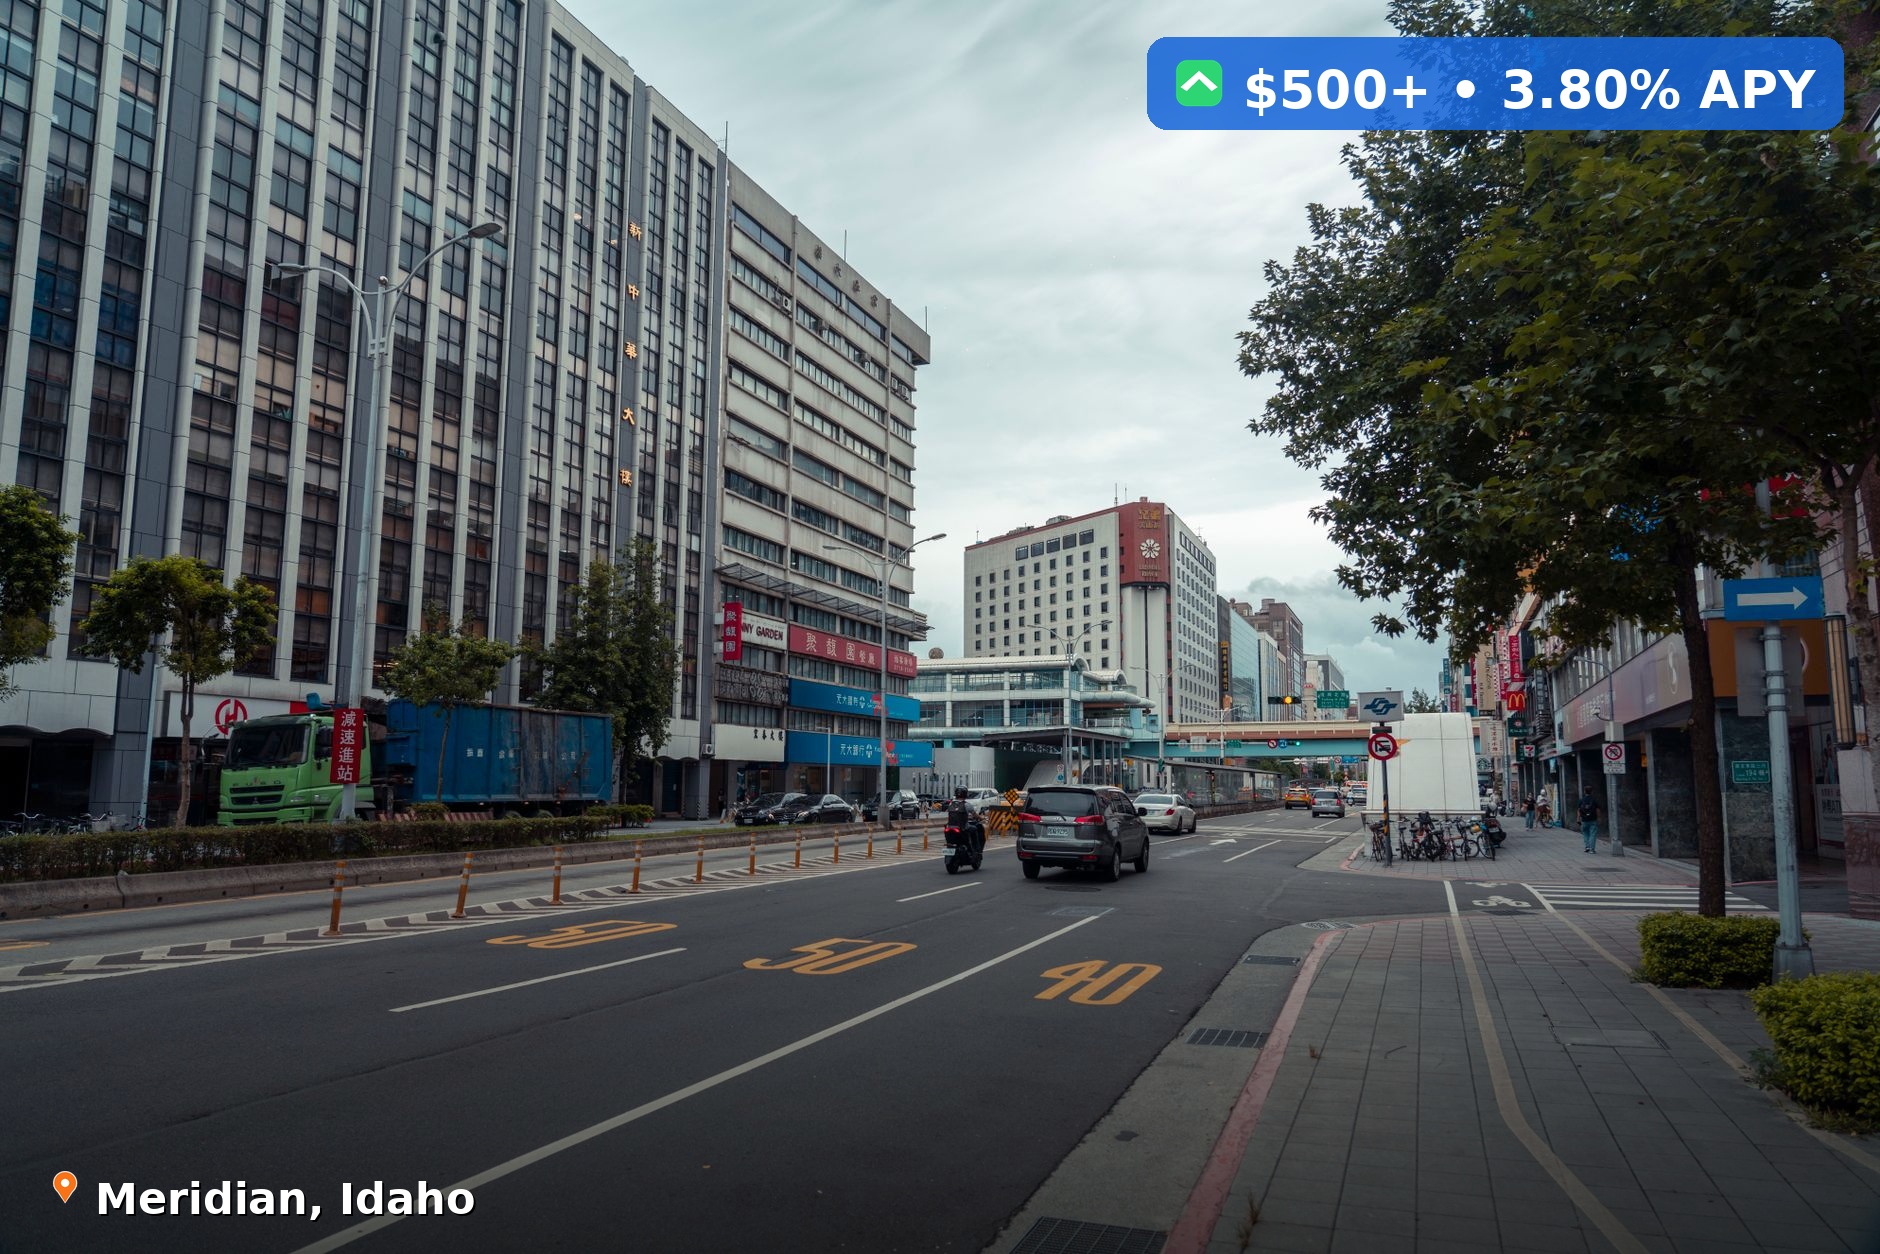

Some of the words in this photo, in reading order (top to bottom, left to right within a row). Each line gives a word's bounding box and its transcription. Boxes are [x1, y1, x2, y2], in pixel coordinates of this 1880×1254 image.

[756, 626, 784, 641] GARDEN
[836, 693, 859, 707] 元大銀行
[337, 711, 357, 782] 減速進站
[840, 743, 865, 757] 元大銀行
[1745, 769, 1757, 777] 194
[486, 919, 678, 949] 50
[742, 937, 918, 974] 50
[1033, 960, 1163, 1004] 40
